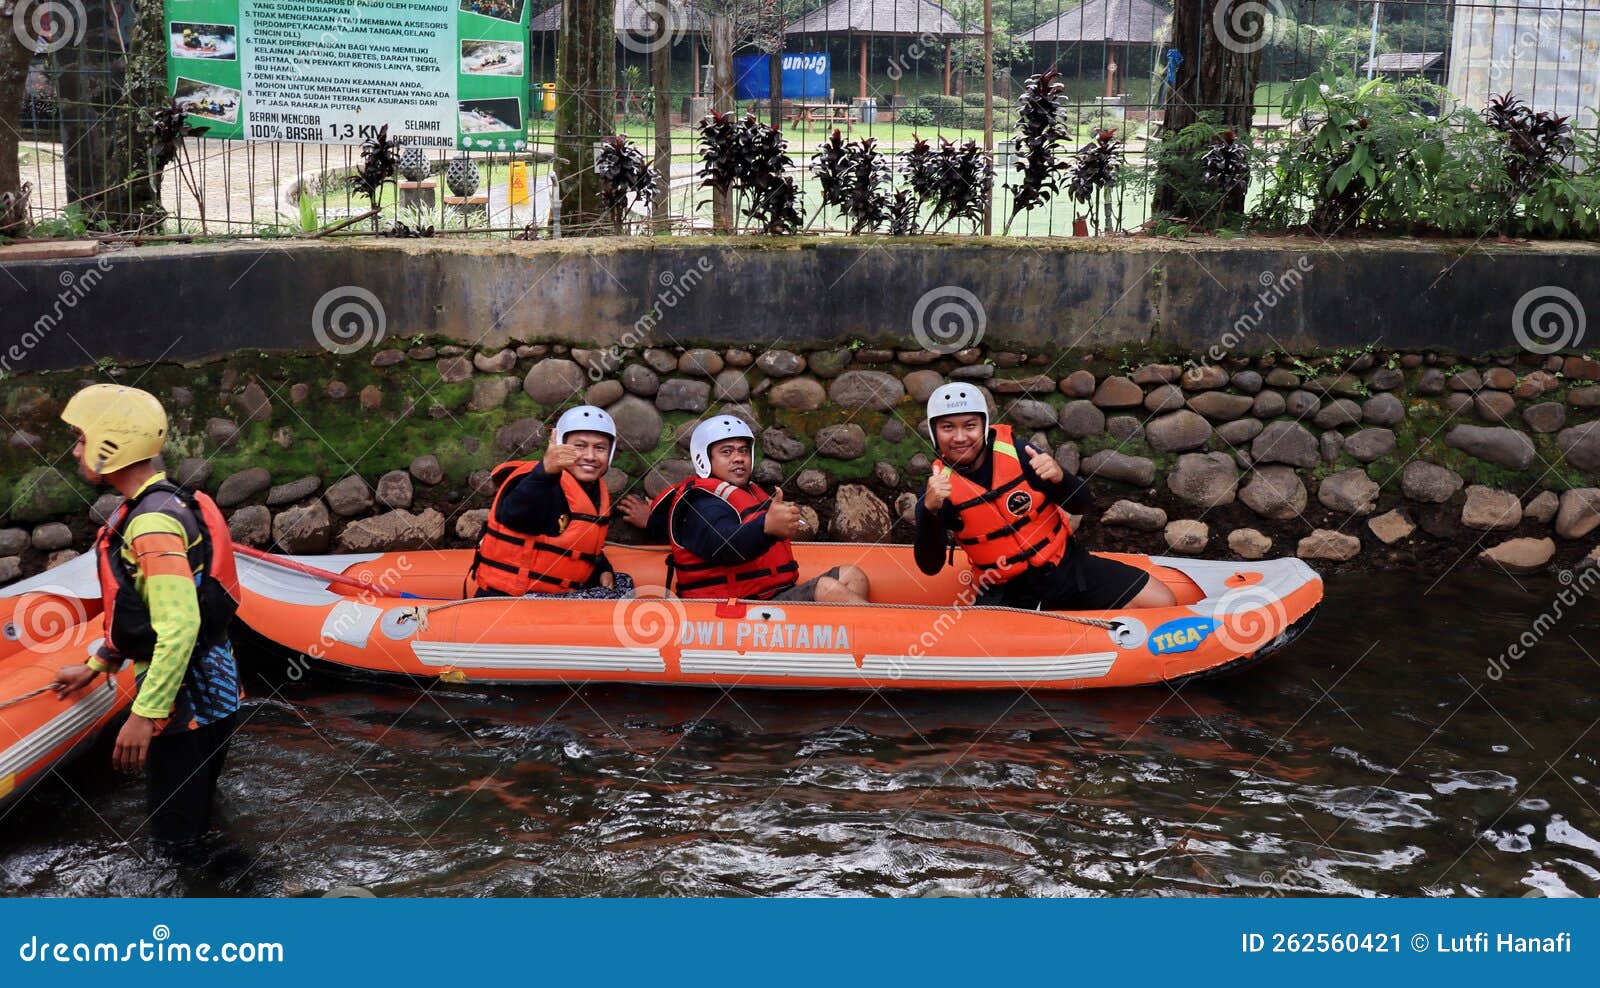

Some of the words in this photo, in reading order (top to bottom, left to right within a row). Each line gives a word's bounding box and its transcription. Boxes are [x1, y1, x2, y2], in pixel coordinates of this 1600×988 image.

[276, 4, 305, 12] SUDAH
[306, 6, 350, 14] DISIAPKAN
[386, 2, 407, 10] OLEH
[408, 4, 448, 12] PEMANDU
[278, 13, 335, 23] MENGENAKAN
[360, 18, 402, 26] MEMBAWA
[404, 21, 448, 29] AKSESORIS
[254, 29, 281, 37] CINCIN
[254, 47, 294, 55] KELAINAN
[392, 46, 428, 54] MEMILIKI
[312, 59, 350, 67] PENYAKIT
[352, 61, 382, 69] KRONIS
[783, 56, 826, 75] Groun
[352, 78, 398, 87] KEAMANAN
[255, 82, 286, 90] MOHON
[288, 84, 315, 92] UNTUK
[316, 85, 360, 94] MEMATUHI
[362, 88, 409, 96] KETENTUAN
[303, 93, 331, 101] SUDAH
[332, 95, 376, 103] TERMASUK
[291, 101, 329, 109] RAHARJA
[249, 111, 279, 123] BERANI
[281, 113, 320, 125] MENCOBA
[405, 120, 440, 131] SELAMAT
[250, 125, 283, 139] 100%
[286, 126, 323, 141] BASAH
[329, 123, 354, 140] 1,3
[681, 621, 724, 646] DWI
[736, 623, 850, 650] PRATAMA
[1153, 627, 1202, 651] TIGA
